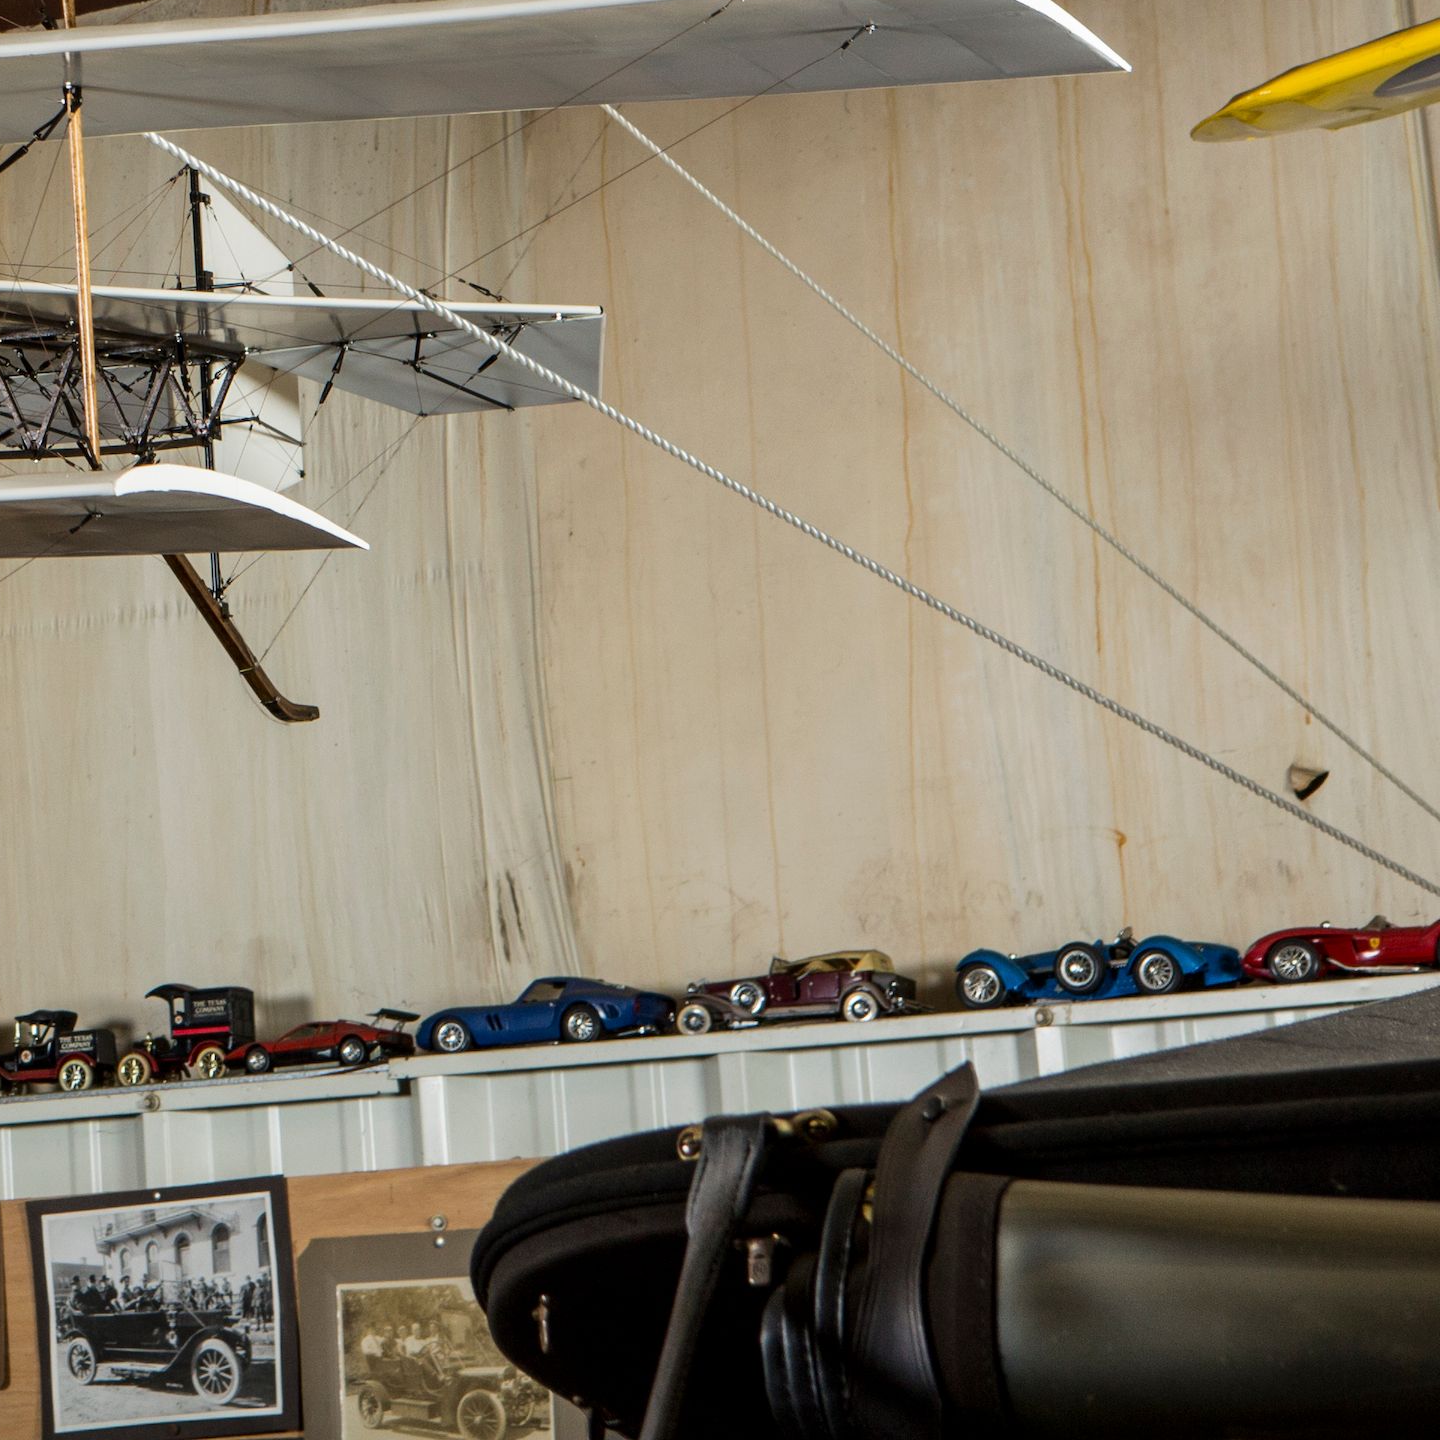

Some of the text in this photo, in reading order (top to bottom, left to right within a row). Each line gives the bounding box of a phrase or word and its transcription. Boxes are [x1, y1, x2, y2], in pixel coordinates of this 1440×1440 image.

[195, 1006, 224, 1014] COMPANY
[73, 1034, 93, 1042] TEXAS
[61, 1042, 91, 1050] COMPANY
